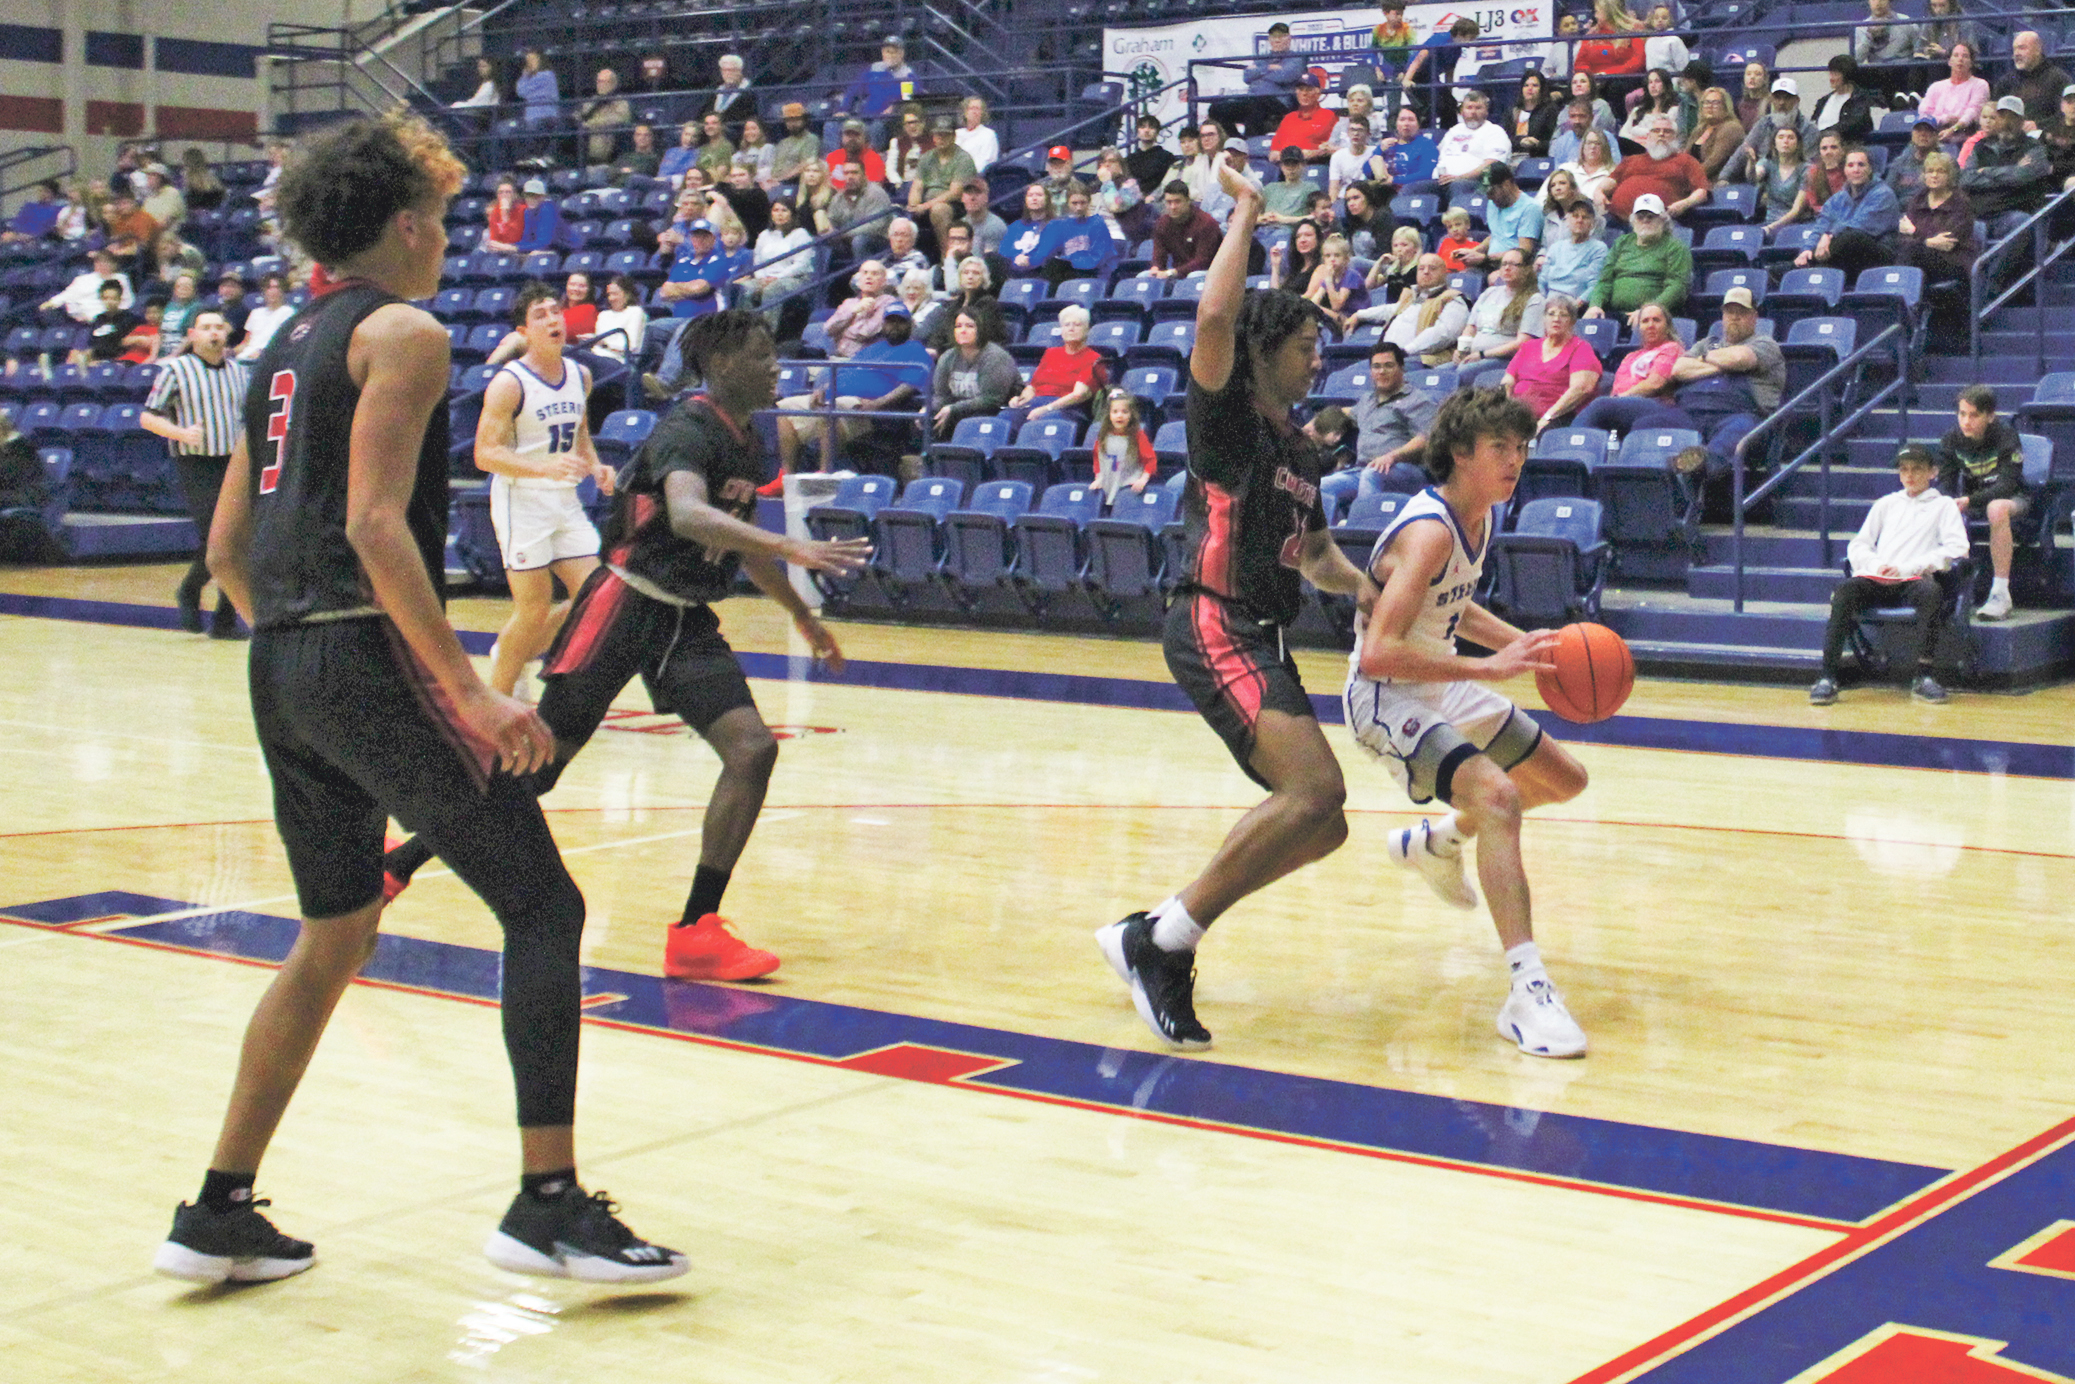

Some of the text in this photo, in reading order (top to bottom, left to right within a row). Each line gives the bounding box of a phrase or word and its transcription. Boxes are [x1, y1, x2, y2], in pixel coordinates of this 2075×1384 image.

[1475, 9, 1505, 33] LJ3
[1112, 37, 1173, 54] Graham
[1332, 35, 1342, 51] &
[260, 369, 297, 495] 3
[548, 422, 576, 454] 15
